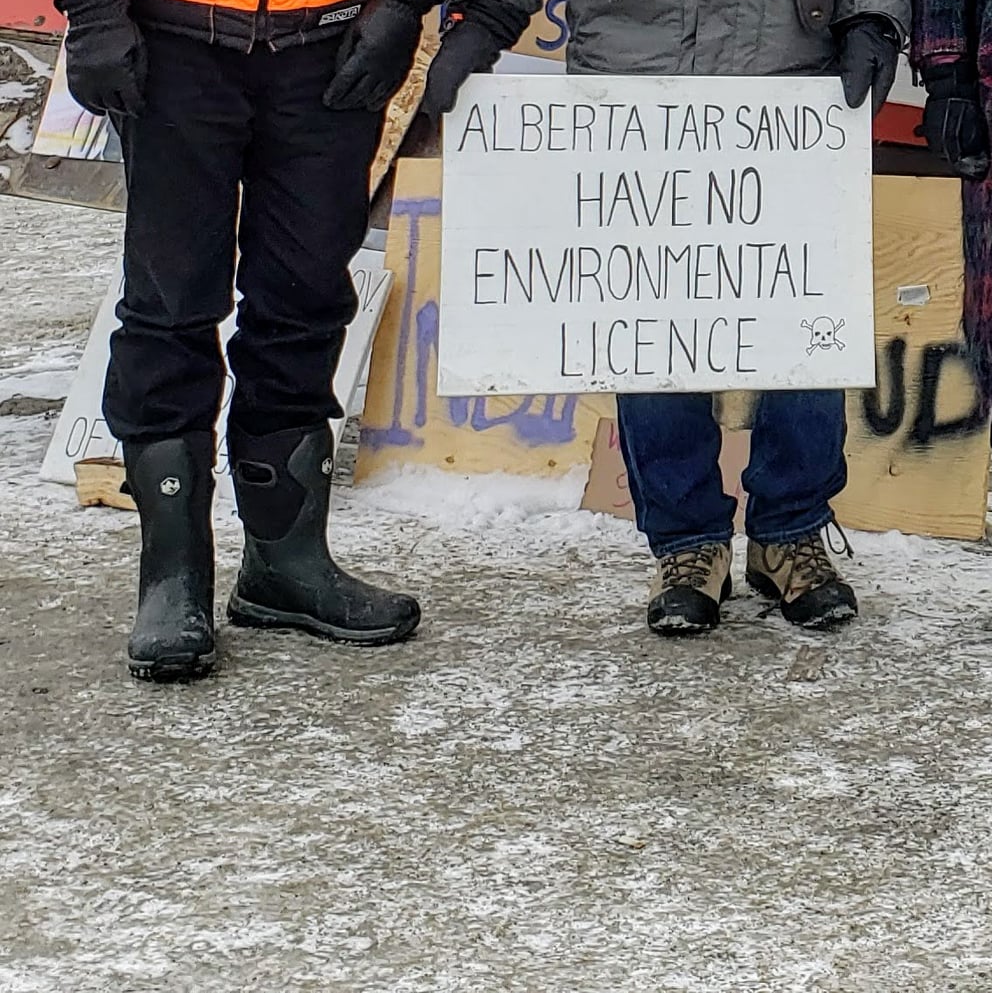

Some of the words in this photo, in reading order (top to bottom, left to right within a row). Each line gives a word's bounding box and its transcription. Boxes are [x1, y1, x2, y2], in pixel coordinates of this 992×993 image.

[457, 103, 647, 153] ALBERTA
[657, 104, 722, 152] TAR
[735, 104, 846, 151] SANDS
[577, 170, 693, 228] HAVE
[707, 166, 762, 225] NO
[474, 243, 824, 305] ENVIRONMENTAL
[561, 317, 757, 377] LICENCE
